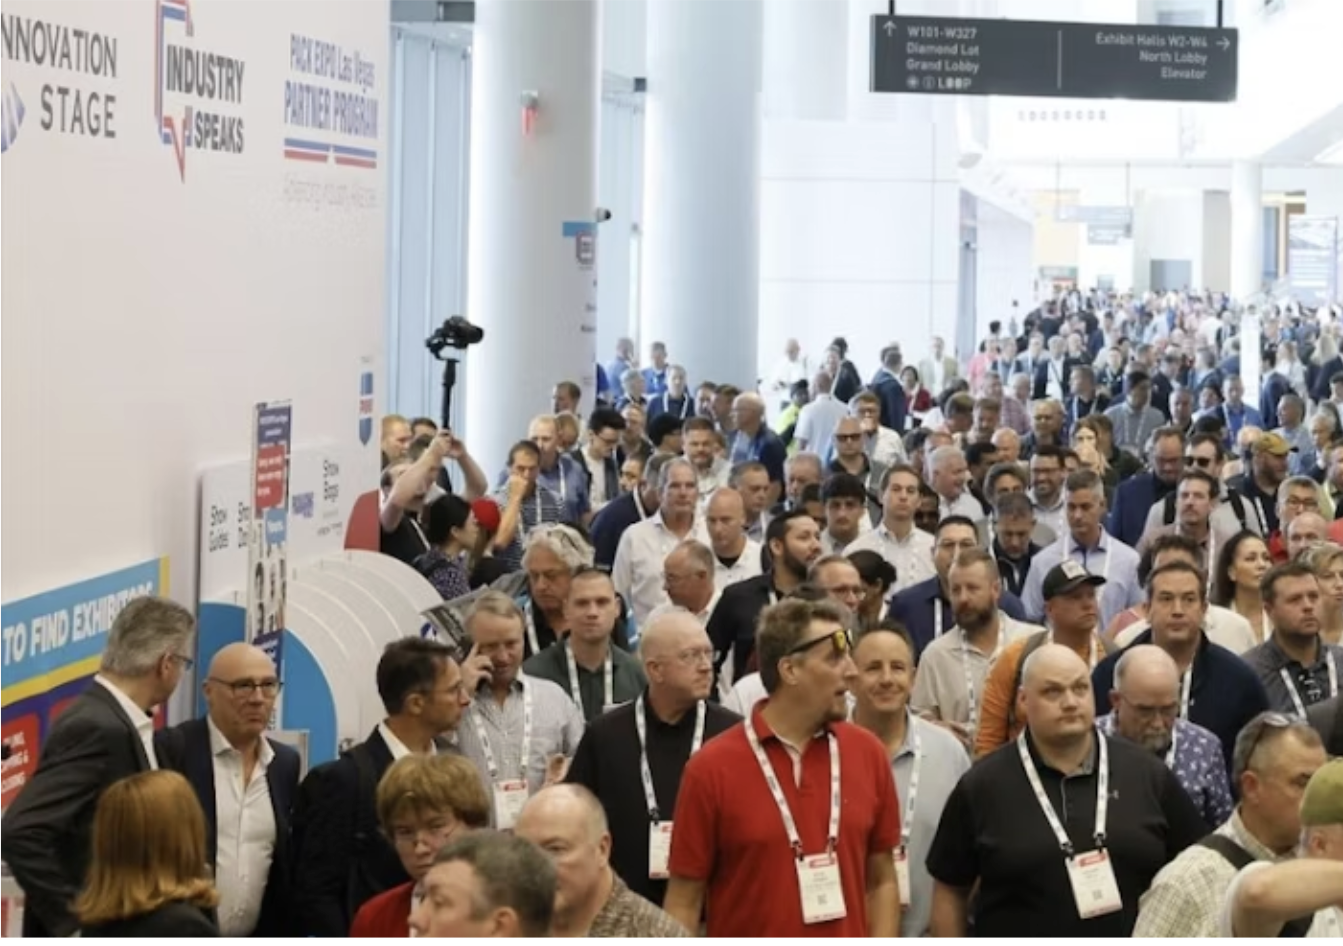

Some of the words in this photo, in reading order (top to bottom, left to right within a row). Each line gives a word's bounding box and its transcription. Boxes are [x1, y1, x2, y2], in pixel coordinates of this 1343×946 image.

[907, 26, 978, 40] W101-W327
[1096, 32, 1135, 46] Exhibit
[1137, 33, 1166, 47] Halls
[289, 32, 313, 74] PACK
[315, 38, 336, 79] EXPO
[337, 45, 352, 83] Las
[354, 49, 375, 93] Vegas
[907, 42, 960, 56] Diamond
[963, 43, 980, 56] Lot
[1139, 50, 1172, 64] North
[1174, 51, 1208, 66] Lobby
[166, 44, 245, 104] INDUSTRY
[906, 58, 942, 72] Grand
[944, 59, 980, 75] Lobby
[1161, 66, 1208, 80] Elevator
[40, 83, 117, 139] STAGE
[284, 78, 331, 131] PARTNER
[332, 89, 379, 139] PROGRAM
[195, 110, 244, 154] SPEAKS
[4, 622, 27, 666] TO
[30, 608, 69, 657] FIND
